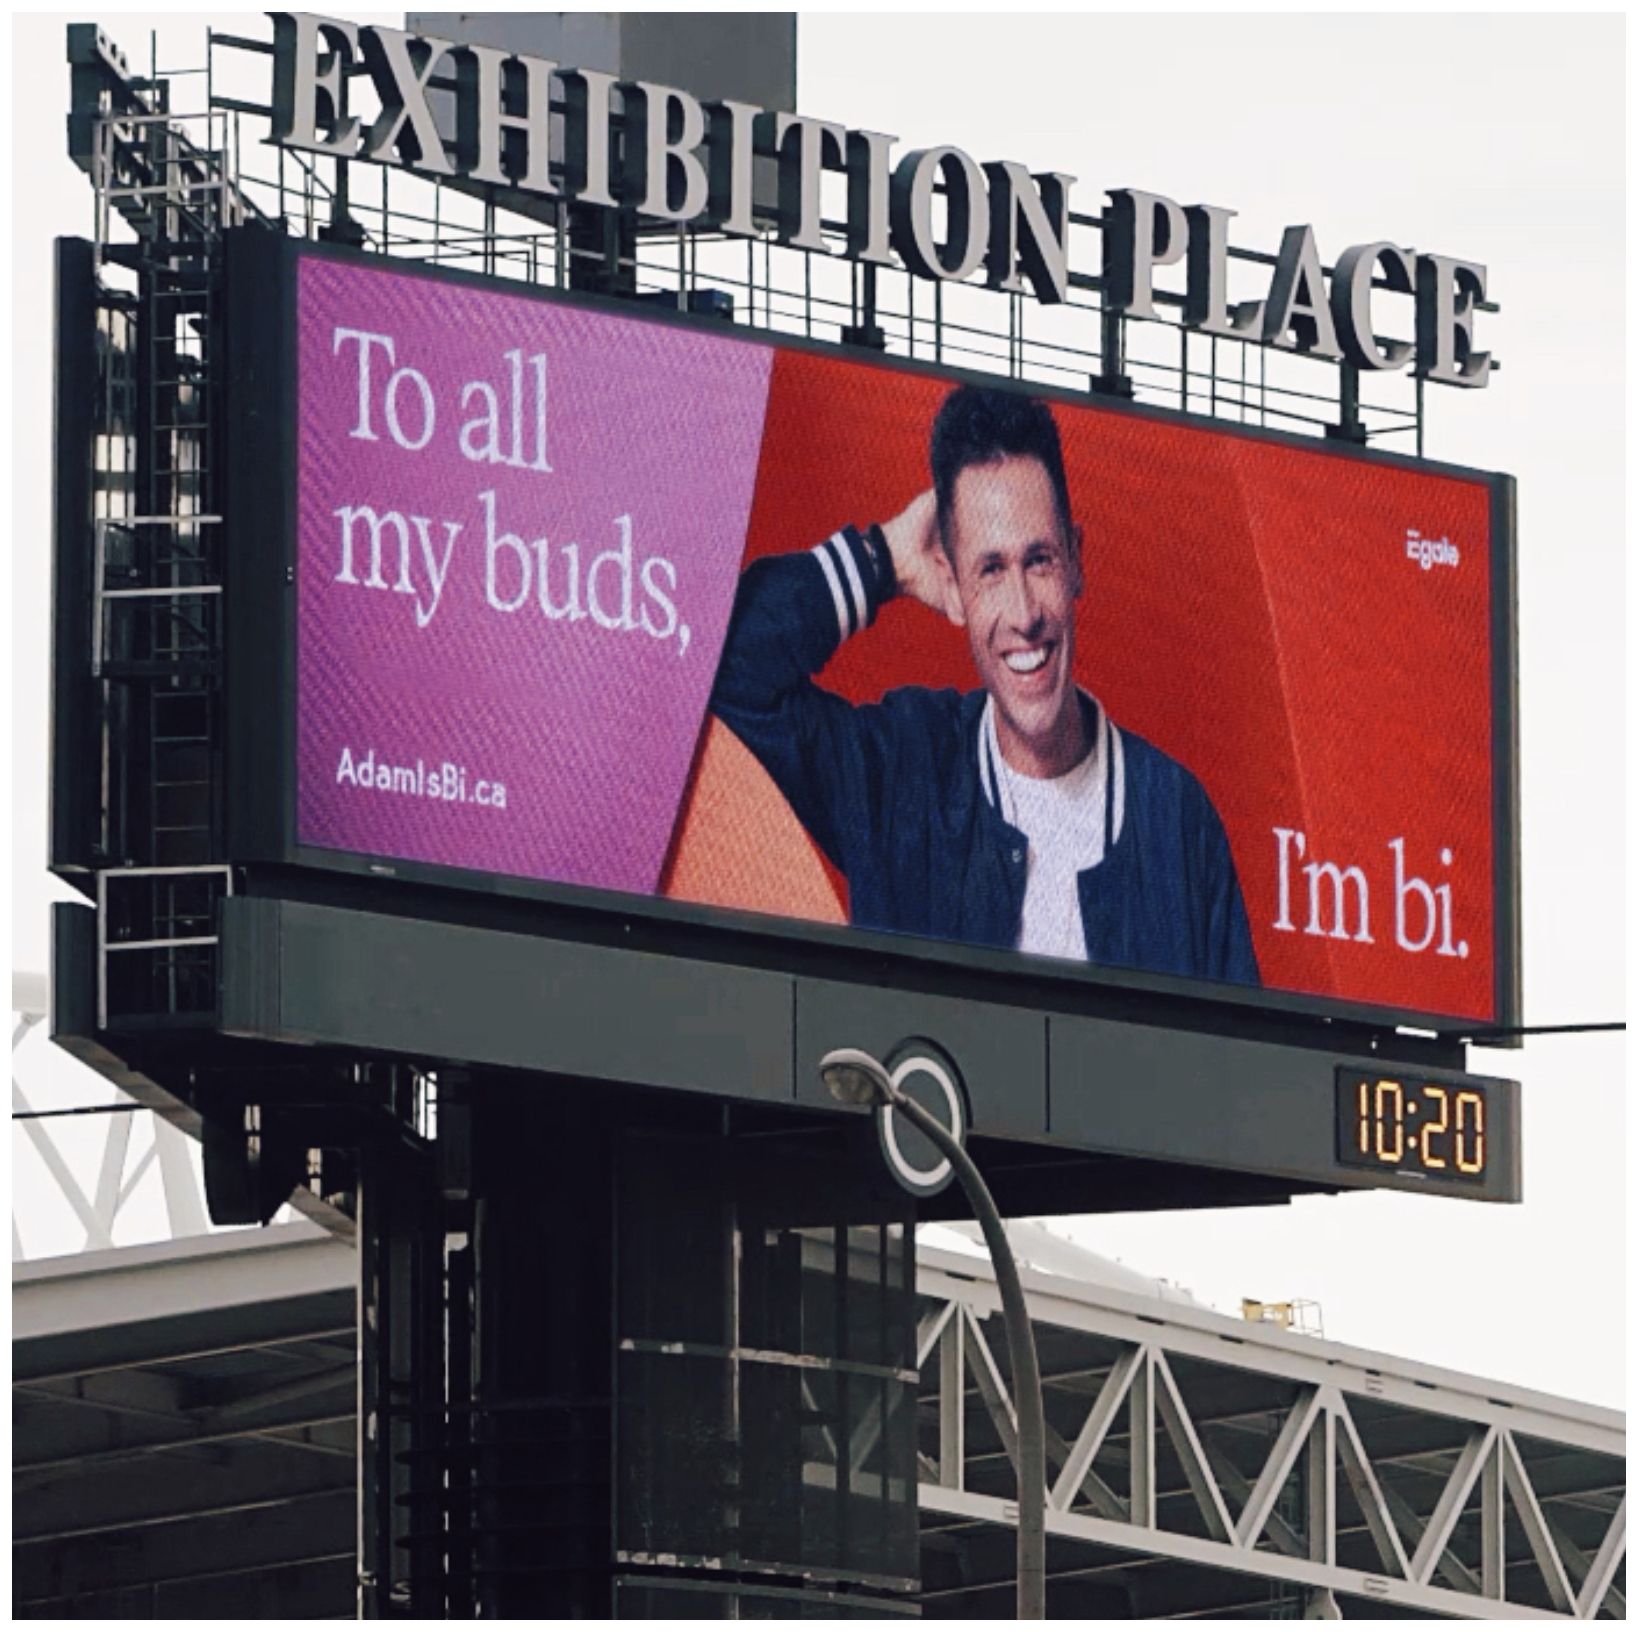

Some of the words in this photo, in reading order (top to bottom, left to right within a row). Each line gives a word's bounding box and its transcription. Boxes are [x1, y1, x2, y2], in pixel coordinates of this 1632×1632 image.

[266, 12, 1078, 304] EXHIBITION
[1106, 188, 1491, 388] PLACE
[334, 328, 436, 451] To
[459, 349, 554, 474] all
[334, 505, 463, 628] my
[478, 490, 693, 657] buds,
[335, 747, 508, 810] AdamIsBi.ca
[1272, 826, 1376, 945] I'm
[1387, 836, 1470, 960] bi.
[1358, 1079, 1483, 1174] 10:20
